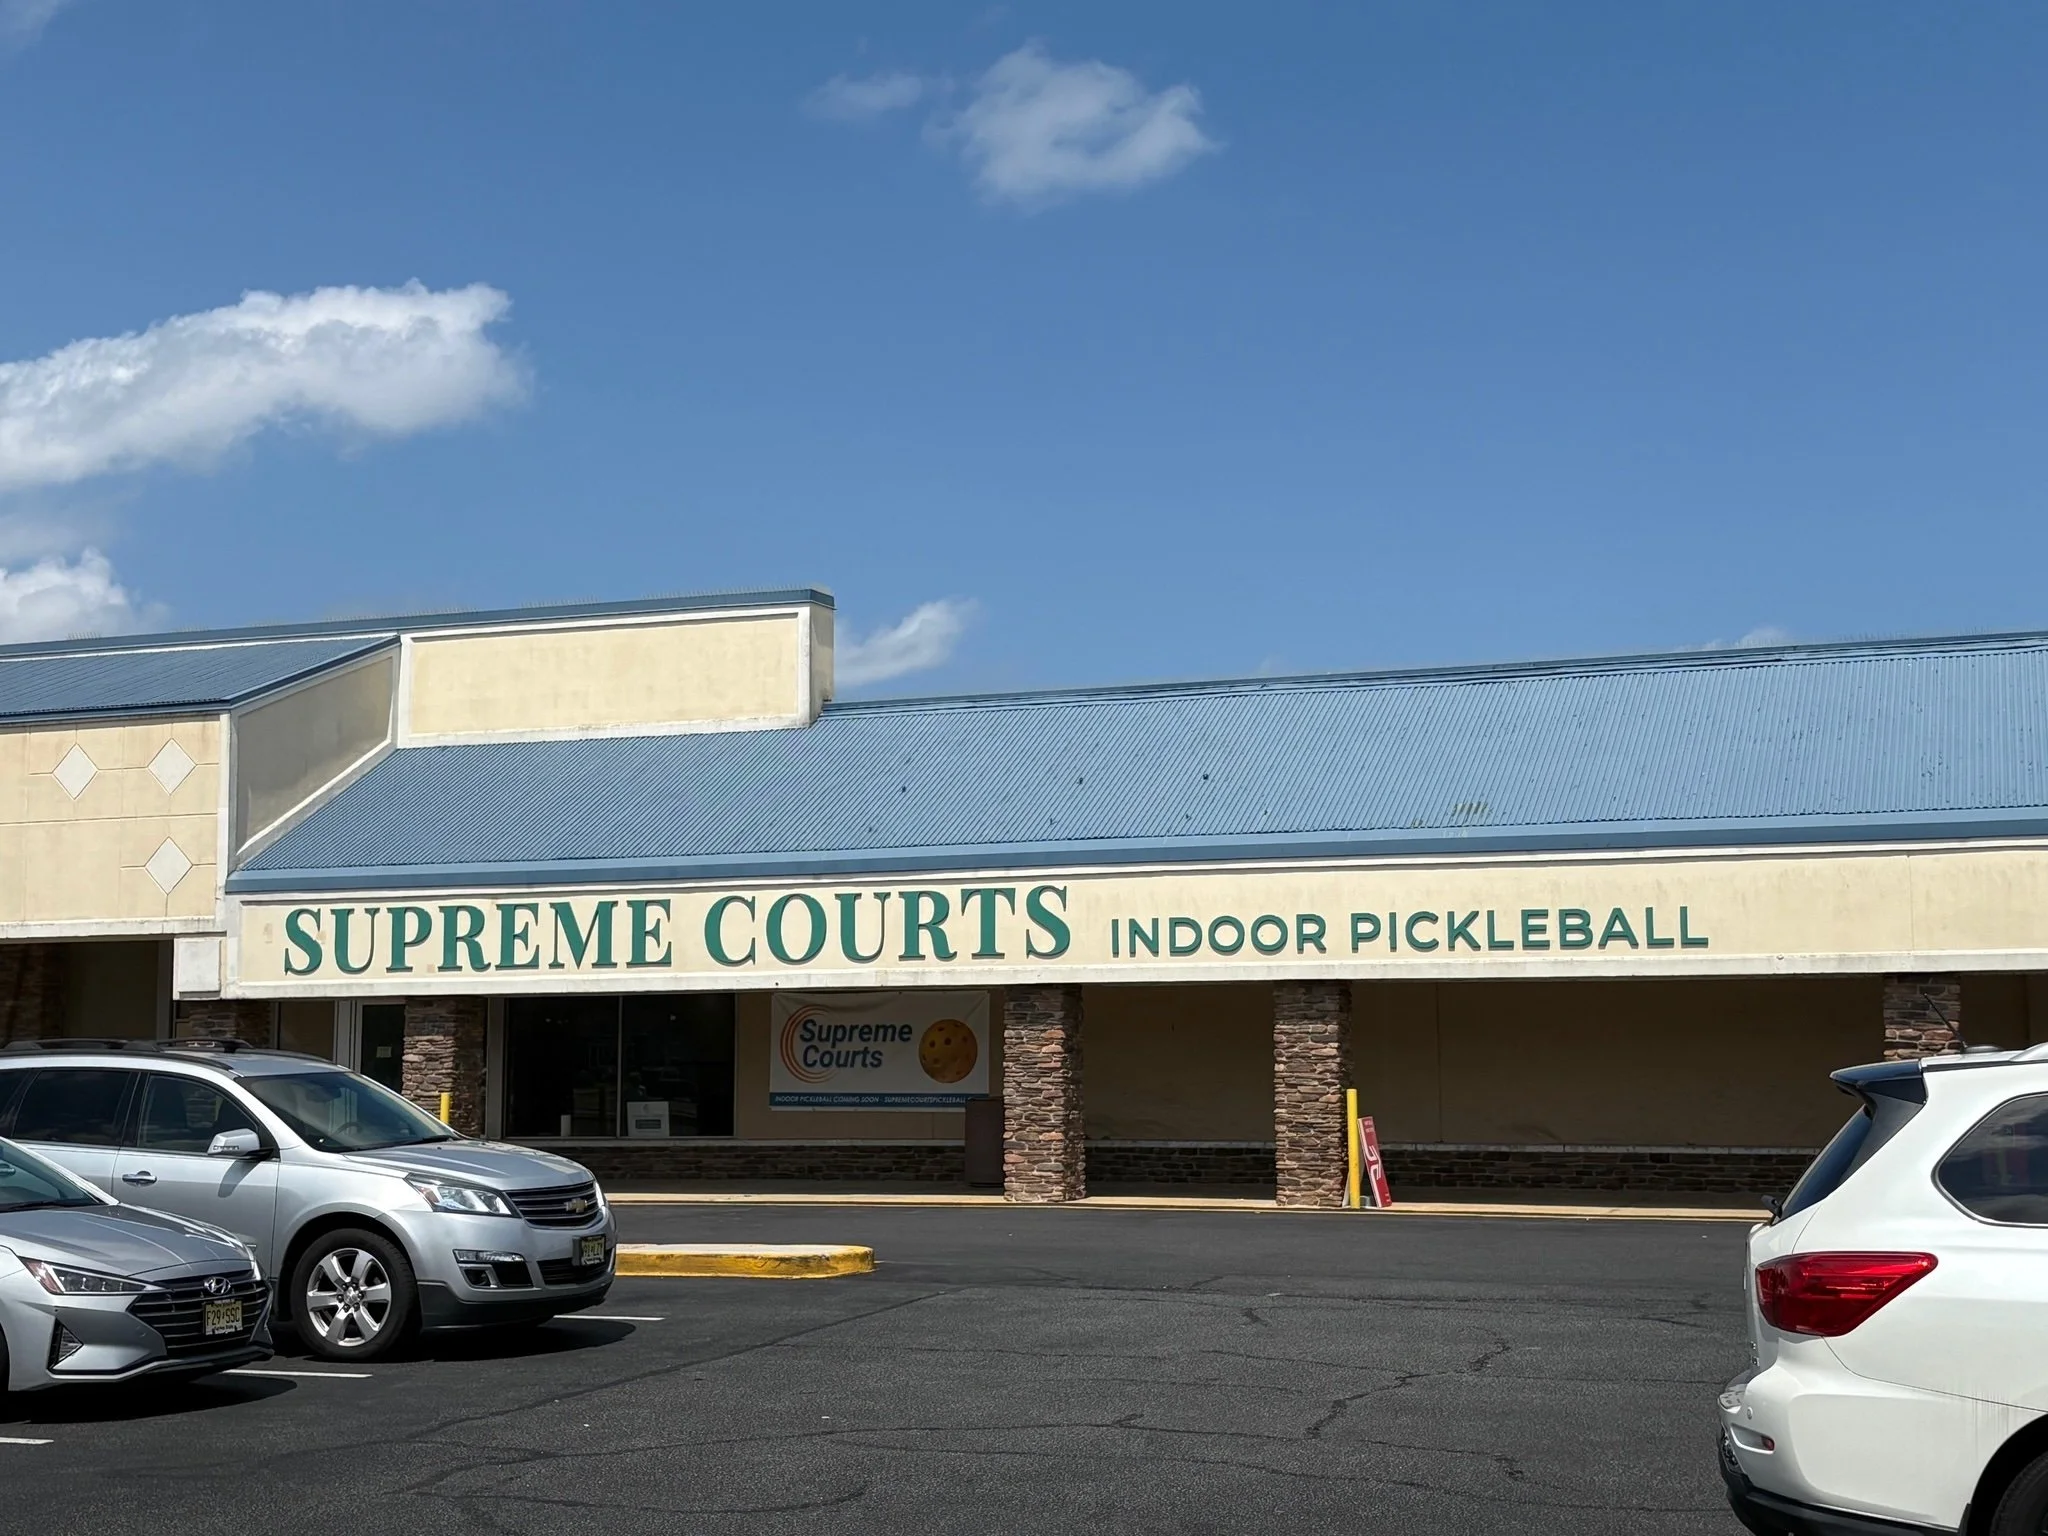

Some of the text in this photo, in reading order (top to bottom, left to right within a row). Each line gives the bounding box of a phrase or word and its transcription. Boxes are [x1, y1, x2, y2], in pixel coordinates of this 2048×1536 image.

[285, 884, 1710, 974] SUPREME COURTS INDOOR PICKLEBALL
[800, 1018, 913, 1048] Supreme
[802, 1044, 884, 1068] Courts
[774, 1095, 966, 1104] INDOOR PICKLEBALL COMING SOON SUPREMECOURTSPICKLEBALL
